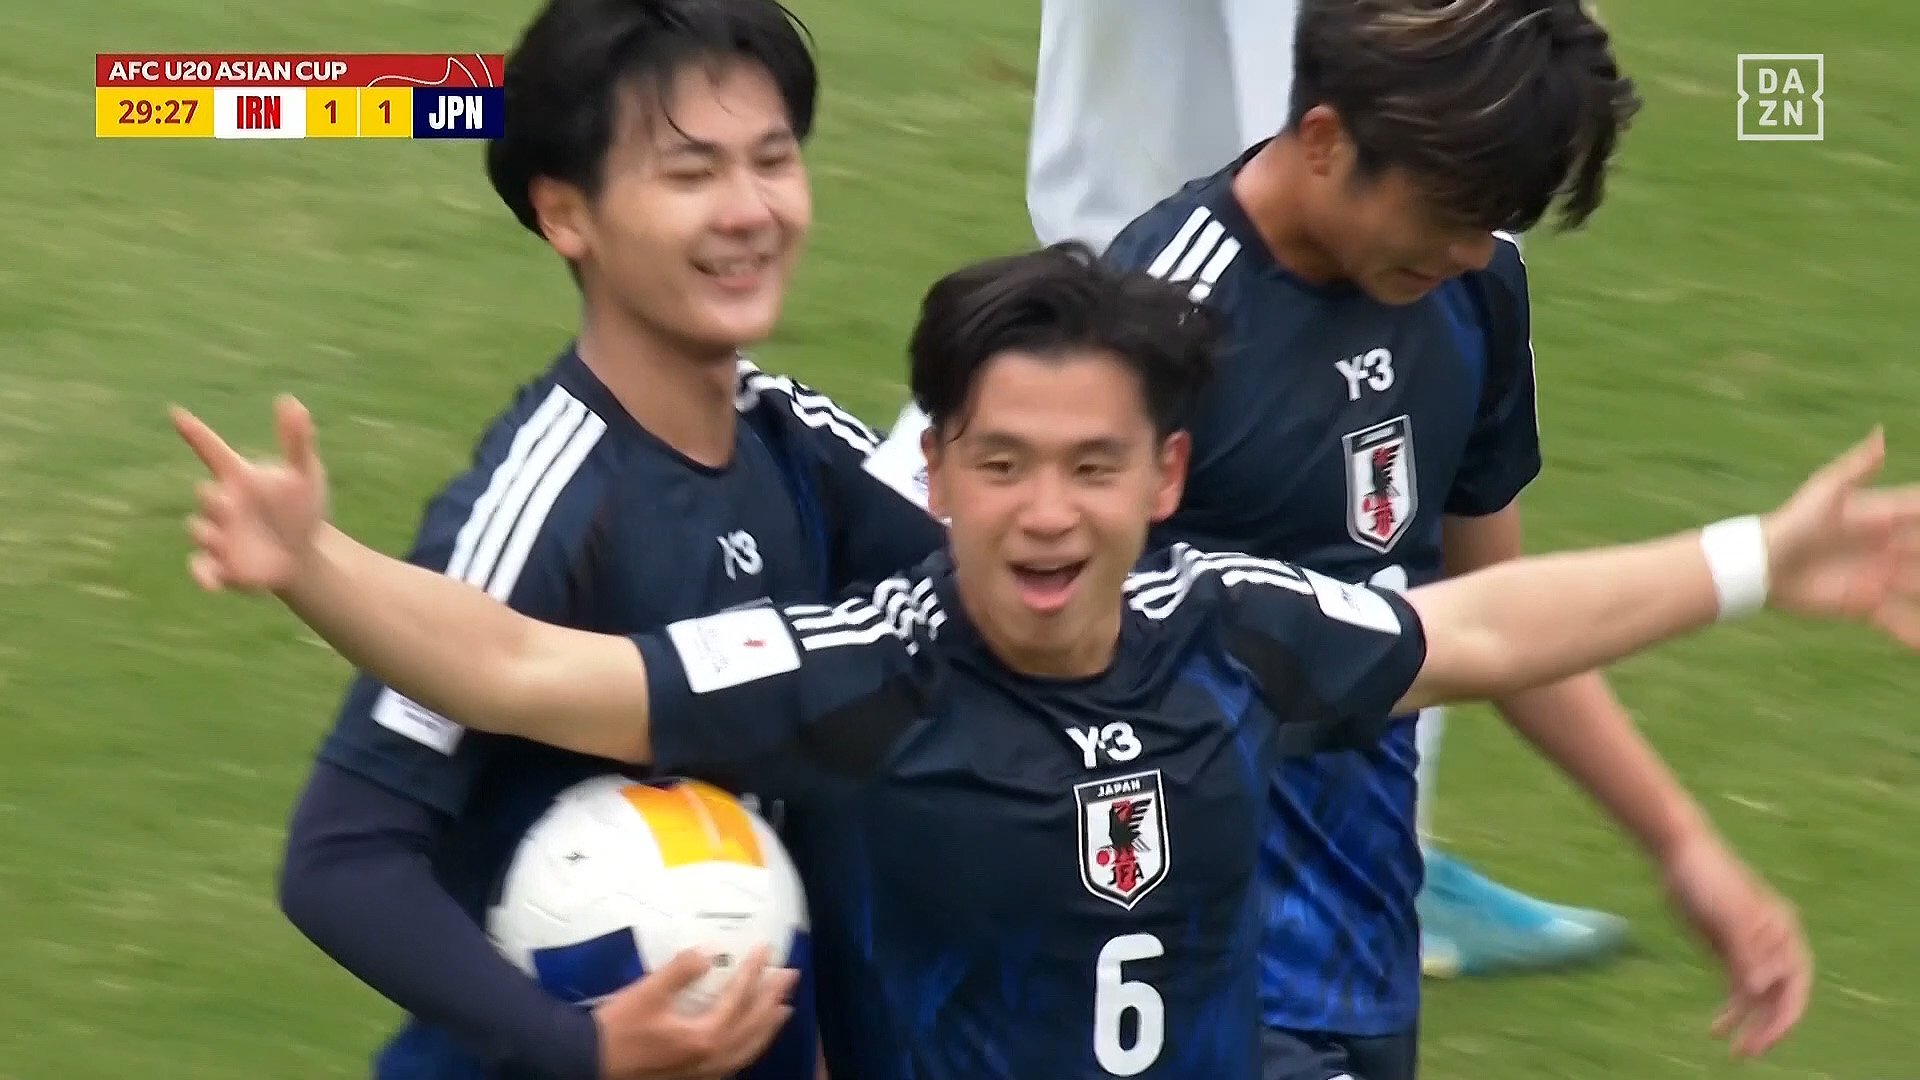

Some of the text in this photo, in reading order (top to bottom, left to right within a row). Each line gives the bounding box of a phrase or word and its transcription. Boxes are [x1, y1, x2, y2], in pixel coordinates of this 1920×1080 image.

[1097, 778, 1141, 798] JAPAN
[1107, 862, 1145, 887] JFA
[1093, 932, 1165, 1077] 6
